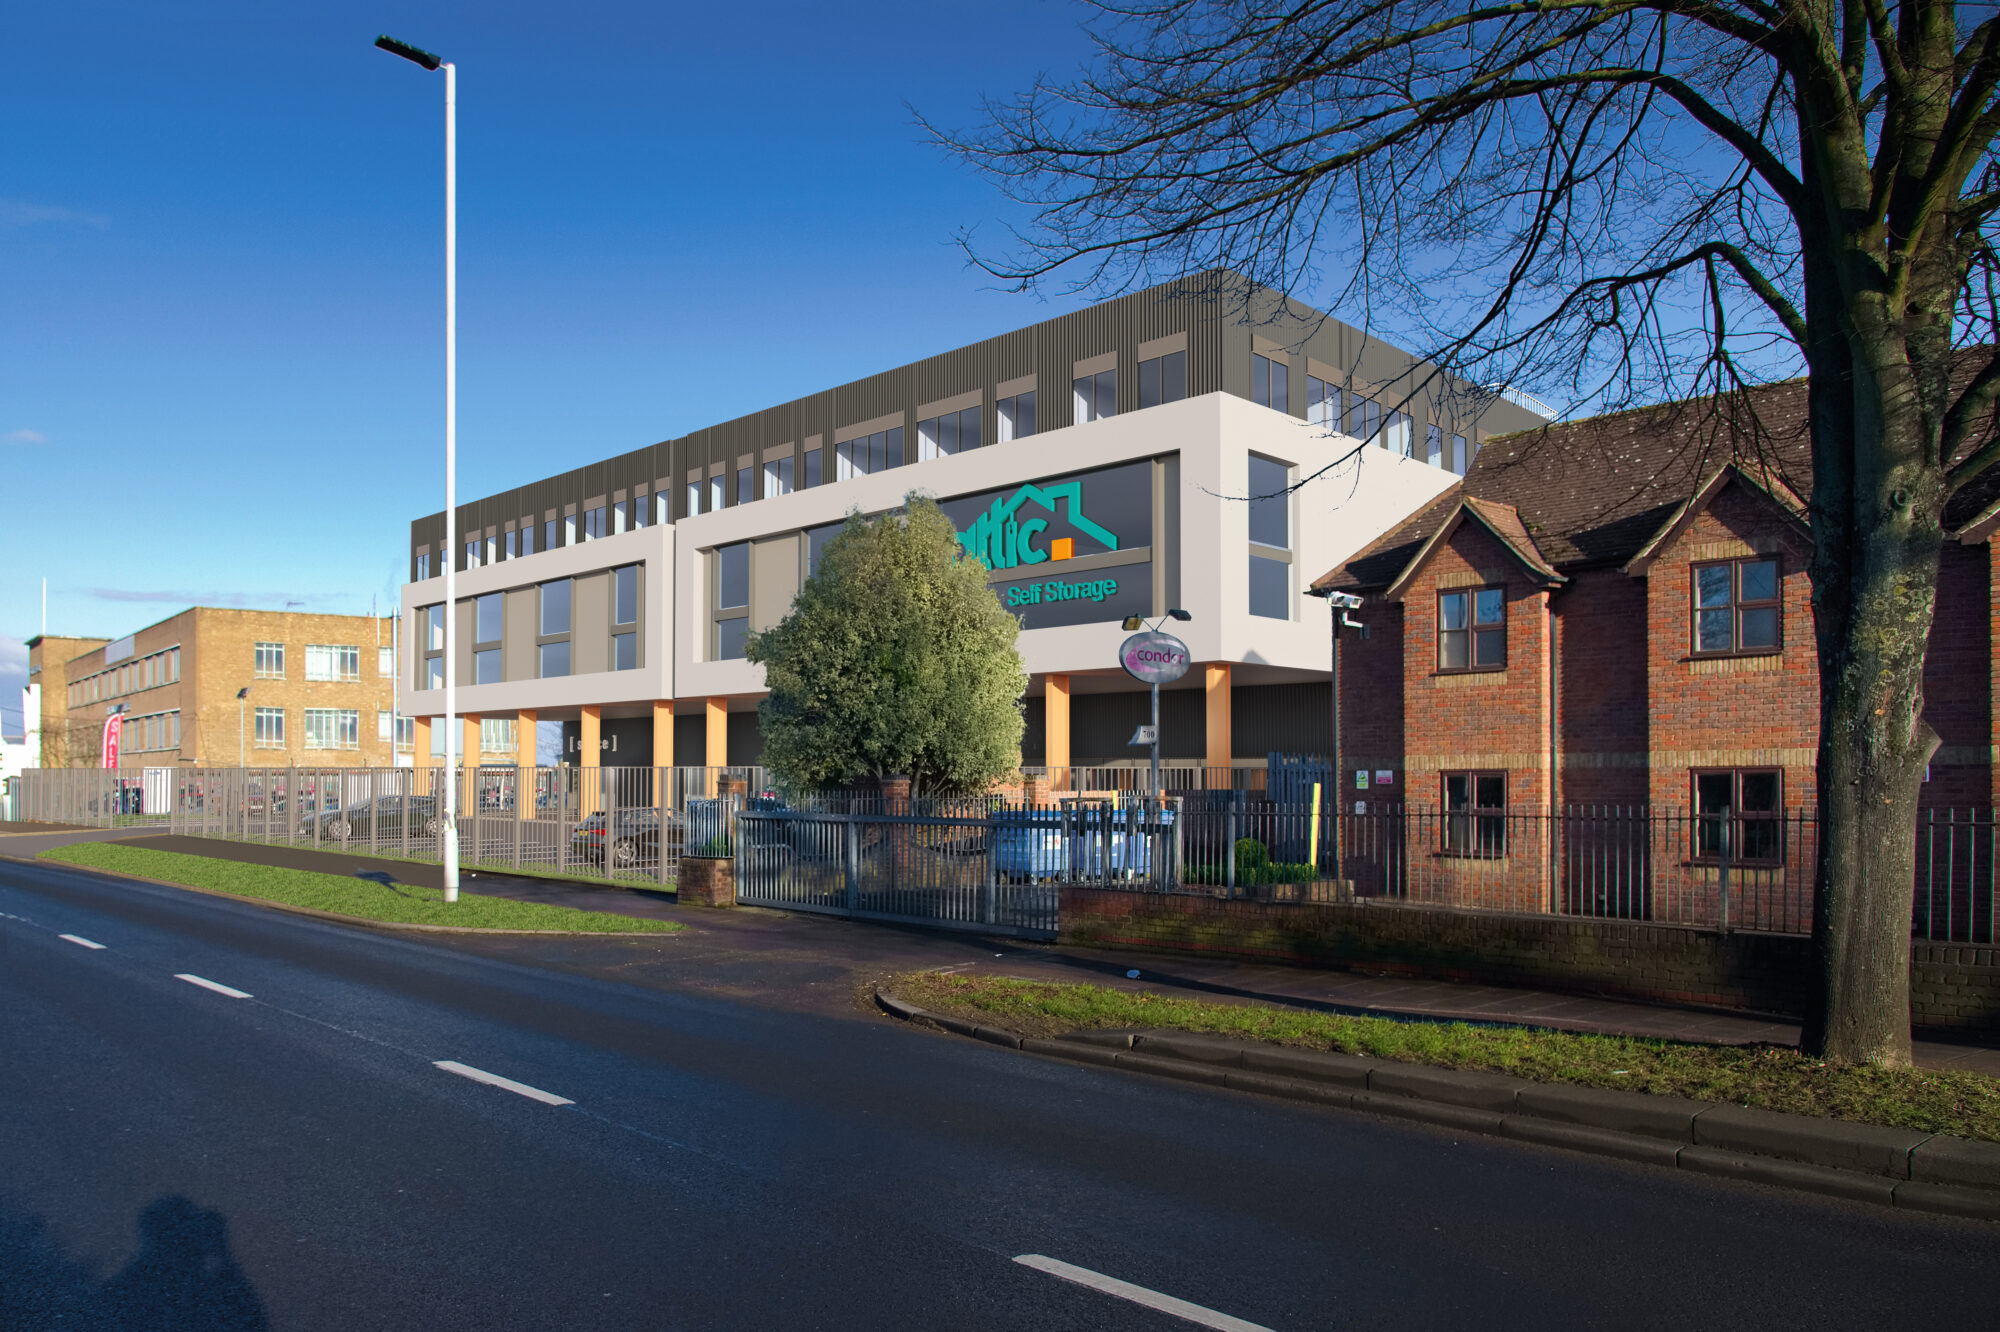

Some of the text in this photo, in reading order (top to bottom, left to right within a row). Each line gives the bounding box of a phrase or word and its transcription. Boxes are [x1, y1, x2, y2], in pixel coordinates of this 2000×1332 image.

[1007, 579, 1117, 606] Self Storage
[1137, 648, 1184, 665] condor
[1143, 730, 1155, 739] 700
